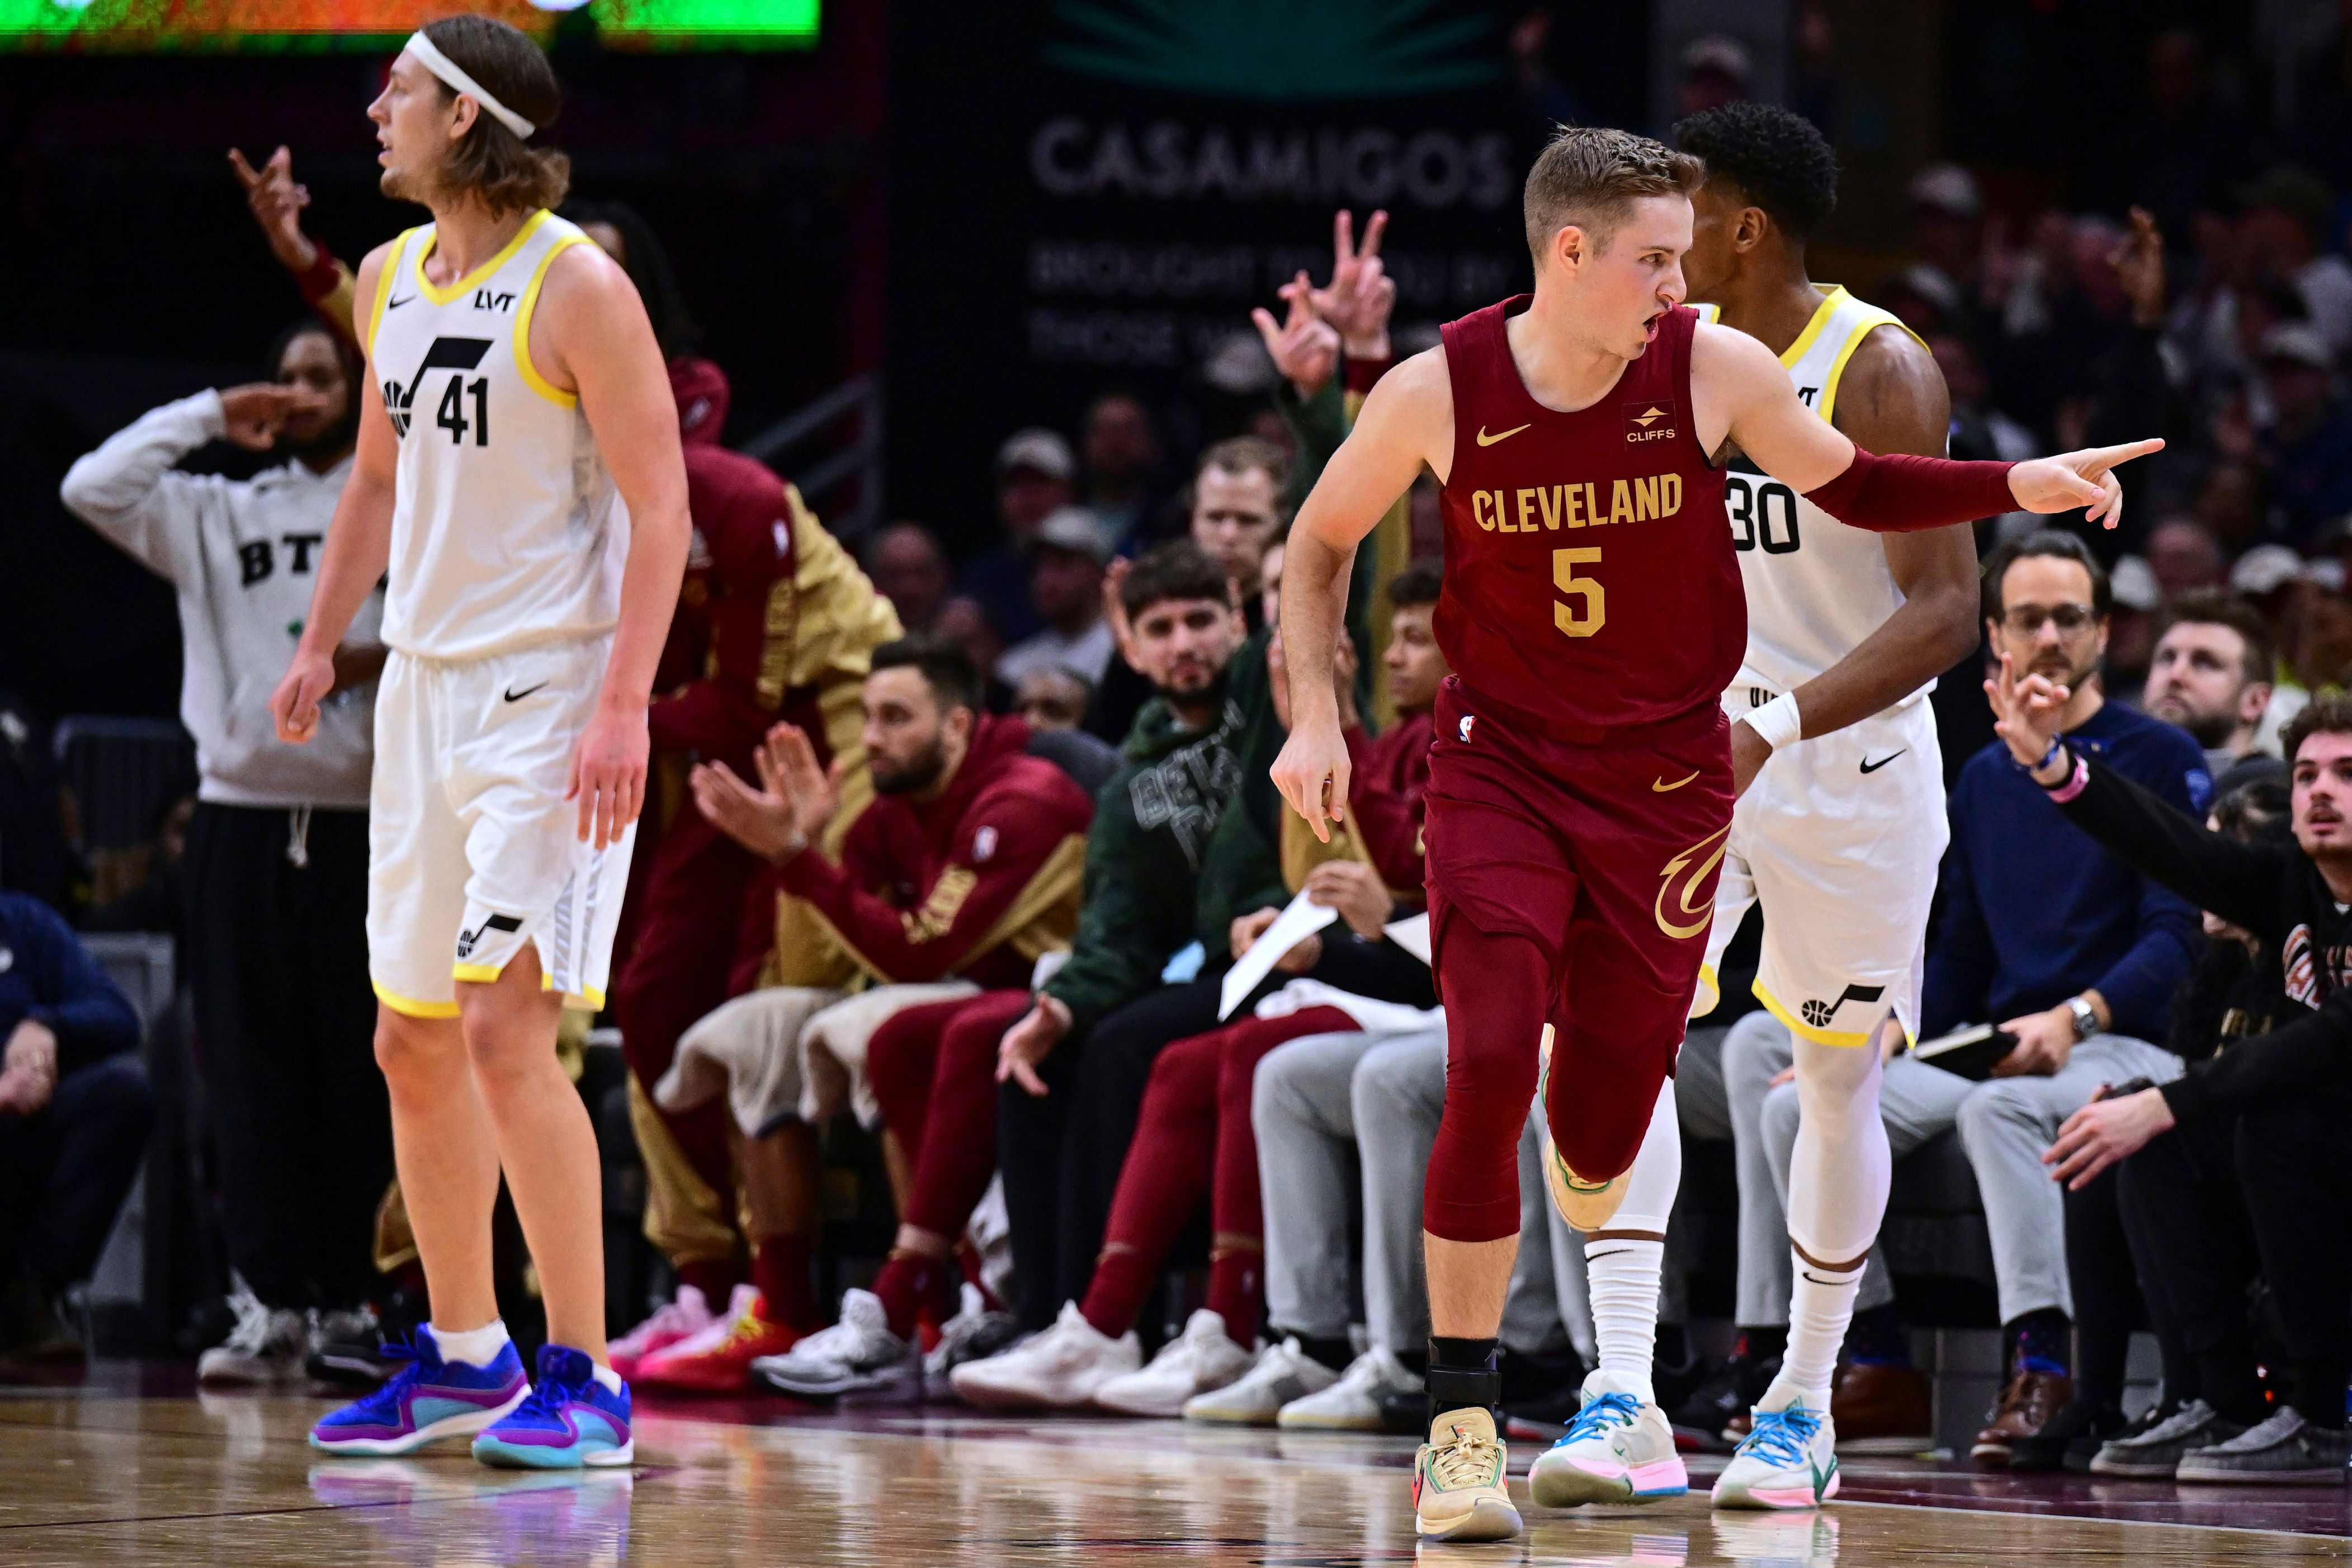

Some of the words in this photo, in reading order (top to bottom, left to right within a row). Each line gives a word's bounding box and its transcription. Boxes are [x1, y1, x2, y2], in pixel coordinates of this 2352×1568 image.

[1029, 116, 1514, 209] CASAMIGOS
[474, 290, 517, 313] LVT
[437, 374, 488, 447] 41
[1627, 428, 1676, 443] CLIFFS
[1472, 472, 1682, 533] CLEVELAND
[1725, 478, 1800, 554] 30
[239, 533, 323, 588] BT
[1552, 546, 1606, 638] 5
